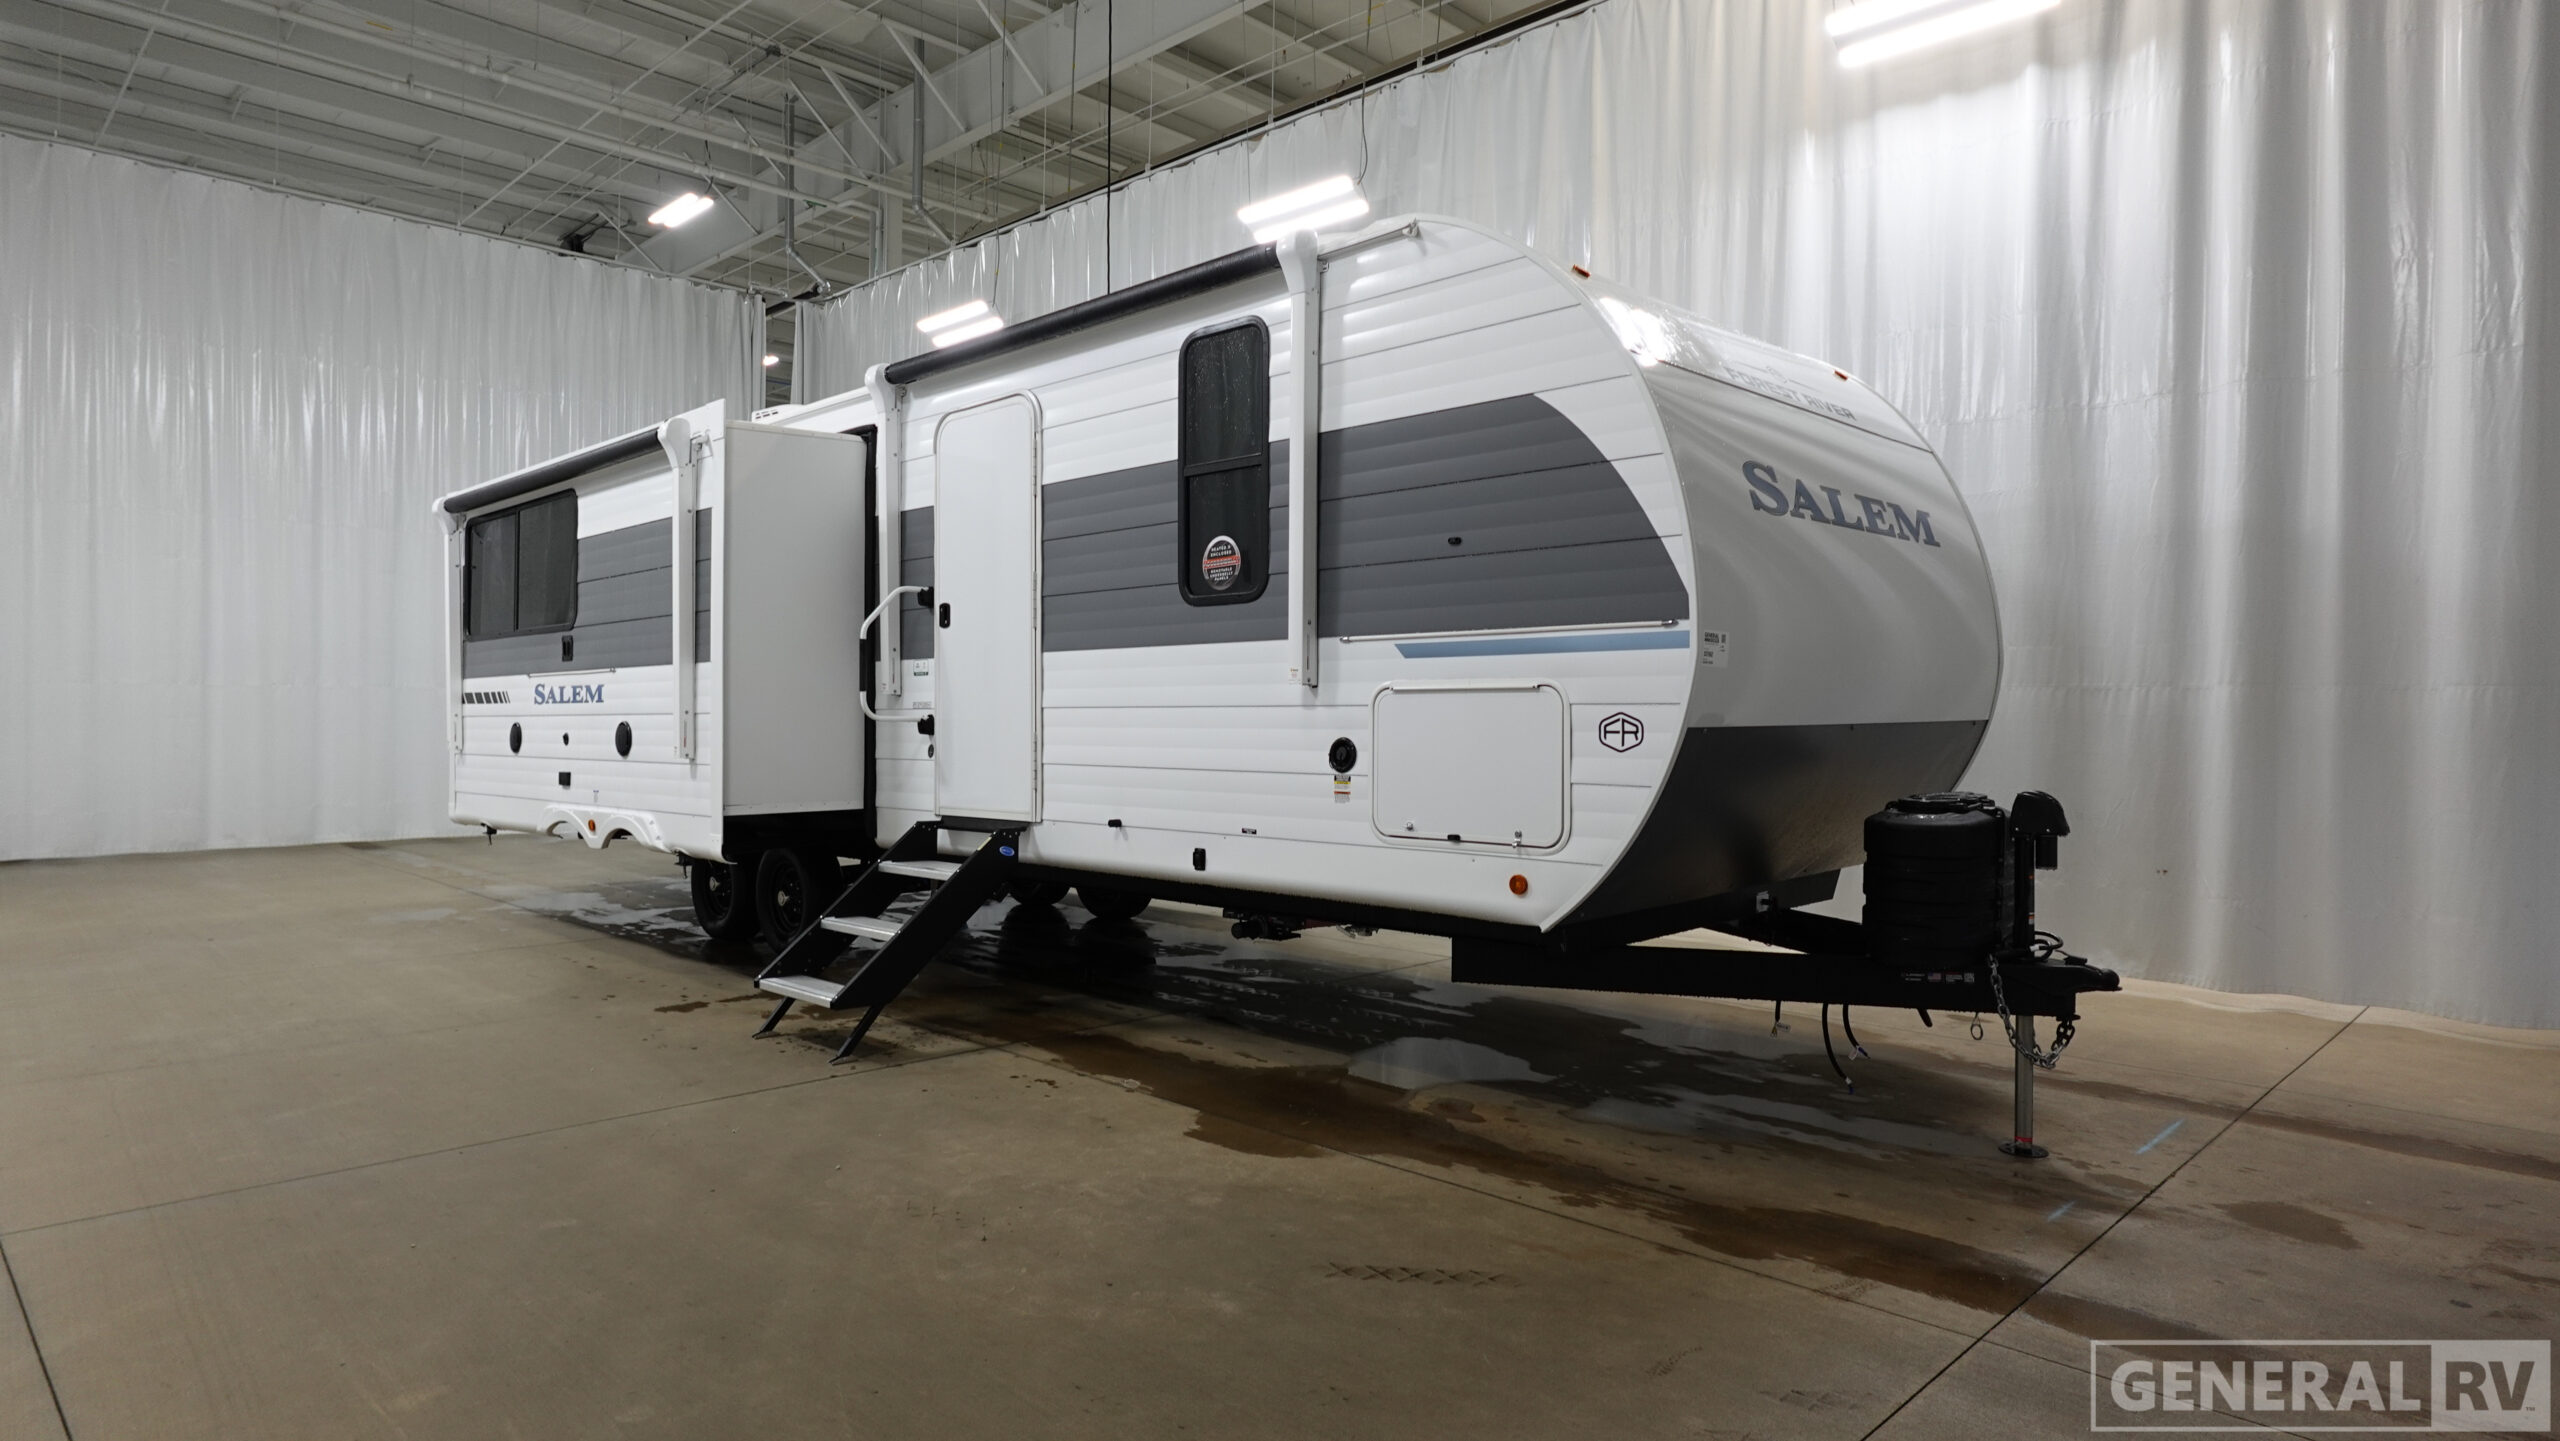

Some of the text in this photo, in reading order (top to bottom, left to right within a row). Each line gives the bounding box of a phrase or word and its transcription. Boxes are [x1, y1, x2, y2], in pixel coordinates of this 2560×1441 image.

[1723, 366, 1856, 421] FOREST RIVER
[1742, 460, 1941, 547] SALEM
[534, 683, 605, 705] SALEM
[1604, 718, 1639, 747] FR
